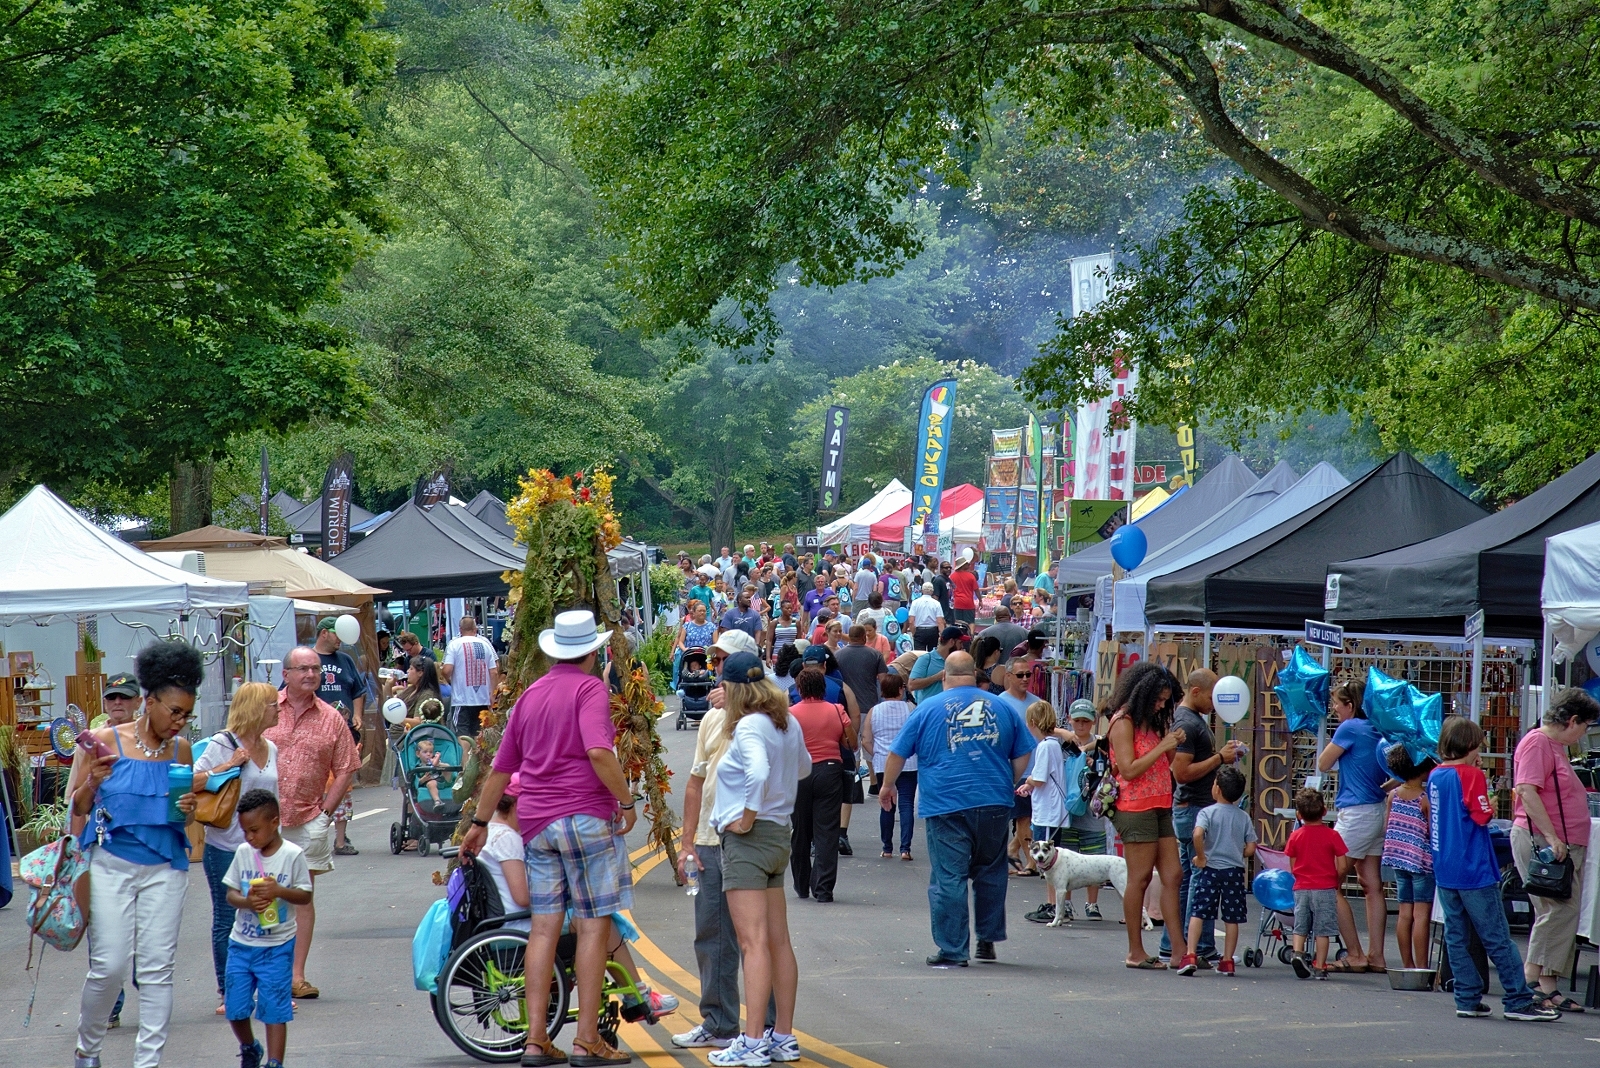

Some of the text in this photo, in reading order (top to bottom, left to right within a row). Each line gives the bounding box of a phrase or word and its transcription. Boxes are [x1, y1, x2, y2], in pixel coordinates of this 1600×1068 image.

[328, 496, 341, 546] FORUM
[1309, 627, 1340, 644] NEW LISTING
[319, 663, 343, 675] GERS
[956, 700, 986, 728] 4
[1430, 781, 1440, 852] KIDSQUEST
[277, 873, 288, 883] OF
